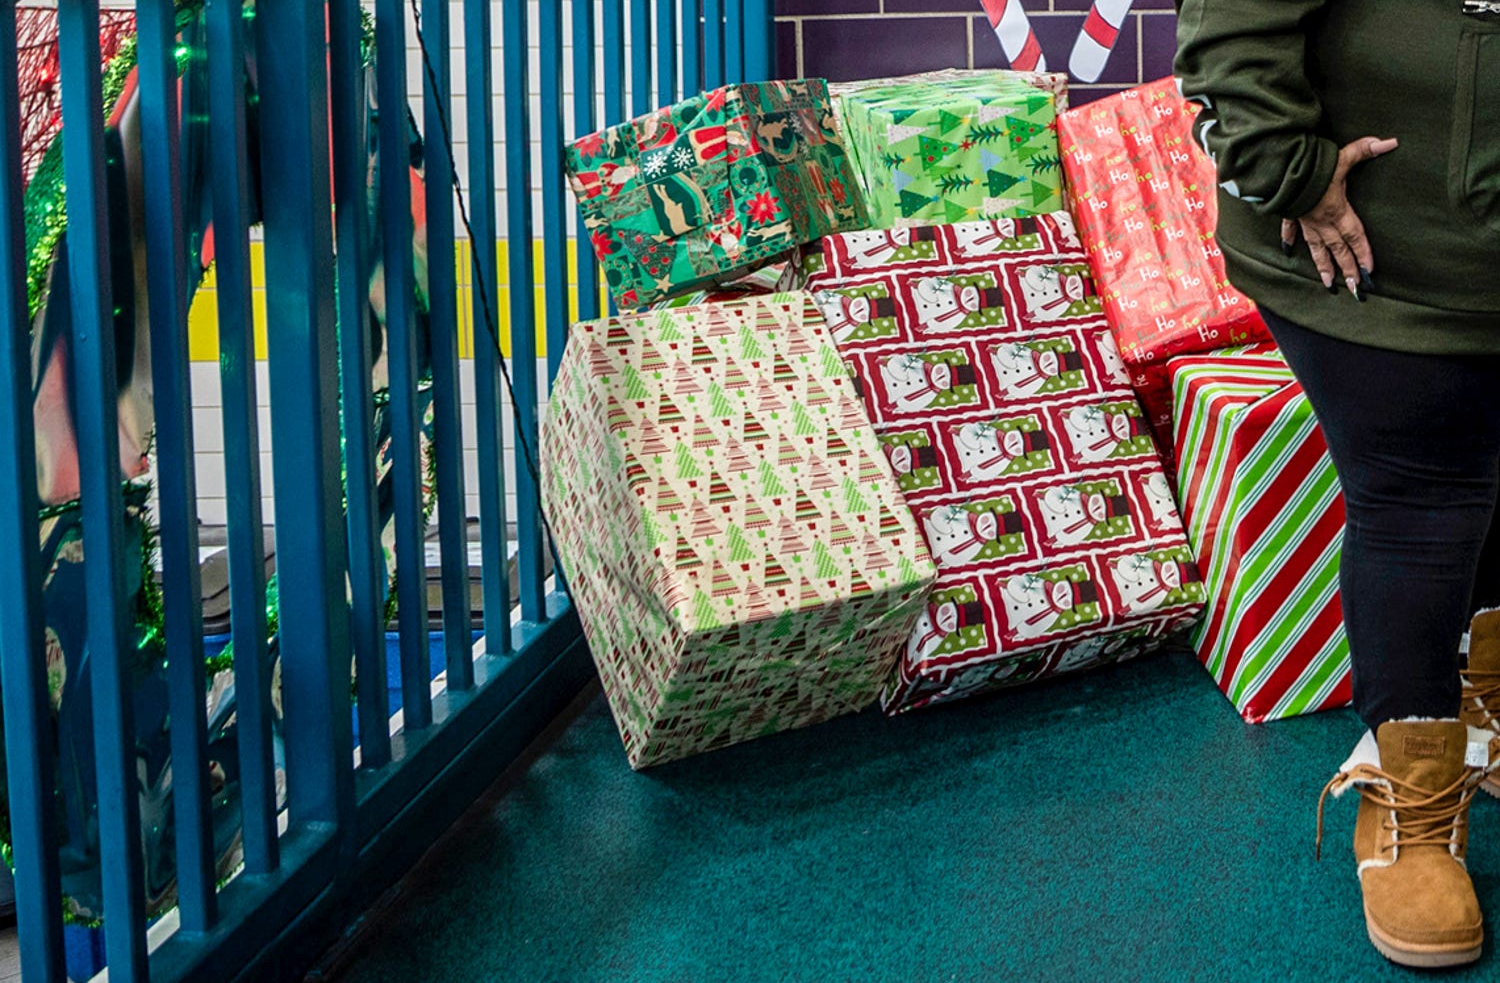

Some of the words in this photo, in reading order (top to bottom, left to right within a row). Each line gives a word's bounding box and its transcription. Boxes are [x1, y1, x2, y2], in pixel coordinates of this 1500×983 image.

[1154, 104, 1172, 118] Ho
[1094, 124, 1114, 138] Ho
[1134, 132, 1152, 146] Ho
[1074, 150, 1092, 165] Ho
[1170, 150, 1188, 164] Ho
[1110, 170, 1128, 184] Ho
[1150, 178, 1169, 192] Ho
[1089, 198, 1108, 212] Ho
[1185, 198, 1204, 212] Ho
[1124, 218, 1144, 233] Ho
[1165, 226, 1184, 242] Ho
[1102, 248, 1122, 264] Ho
[1202, 246, 1221, 260] Ho
[1140, 266, 1159, 282] Ho
[1181, 276, 1200, 290] Ho
[1118, 296, 1137, 312] Ho
[1219, 294, 1238, 308] Ho
[1156, 316, 1176, 332] Ho
[1197, 326, 1218, 342] Ho
[1133, 348, 1154, 364] Ho
